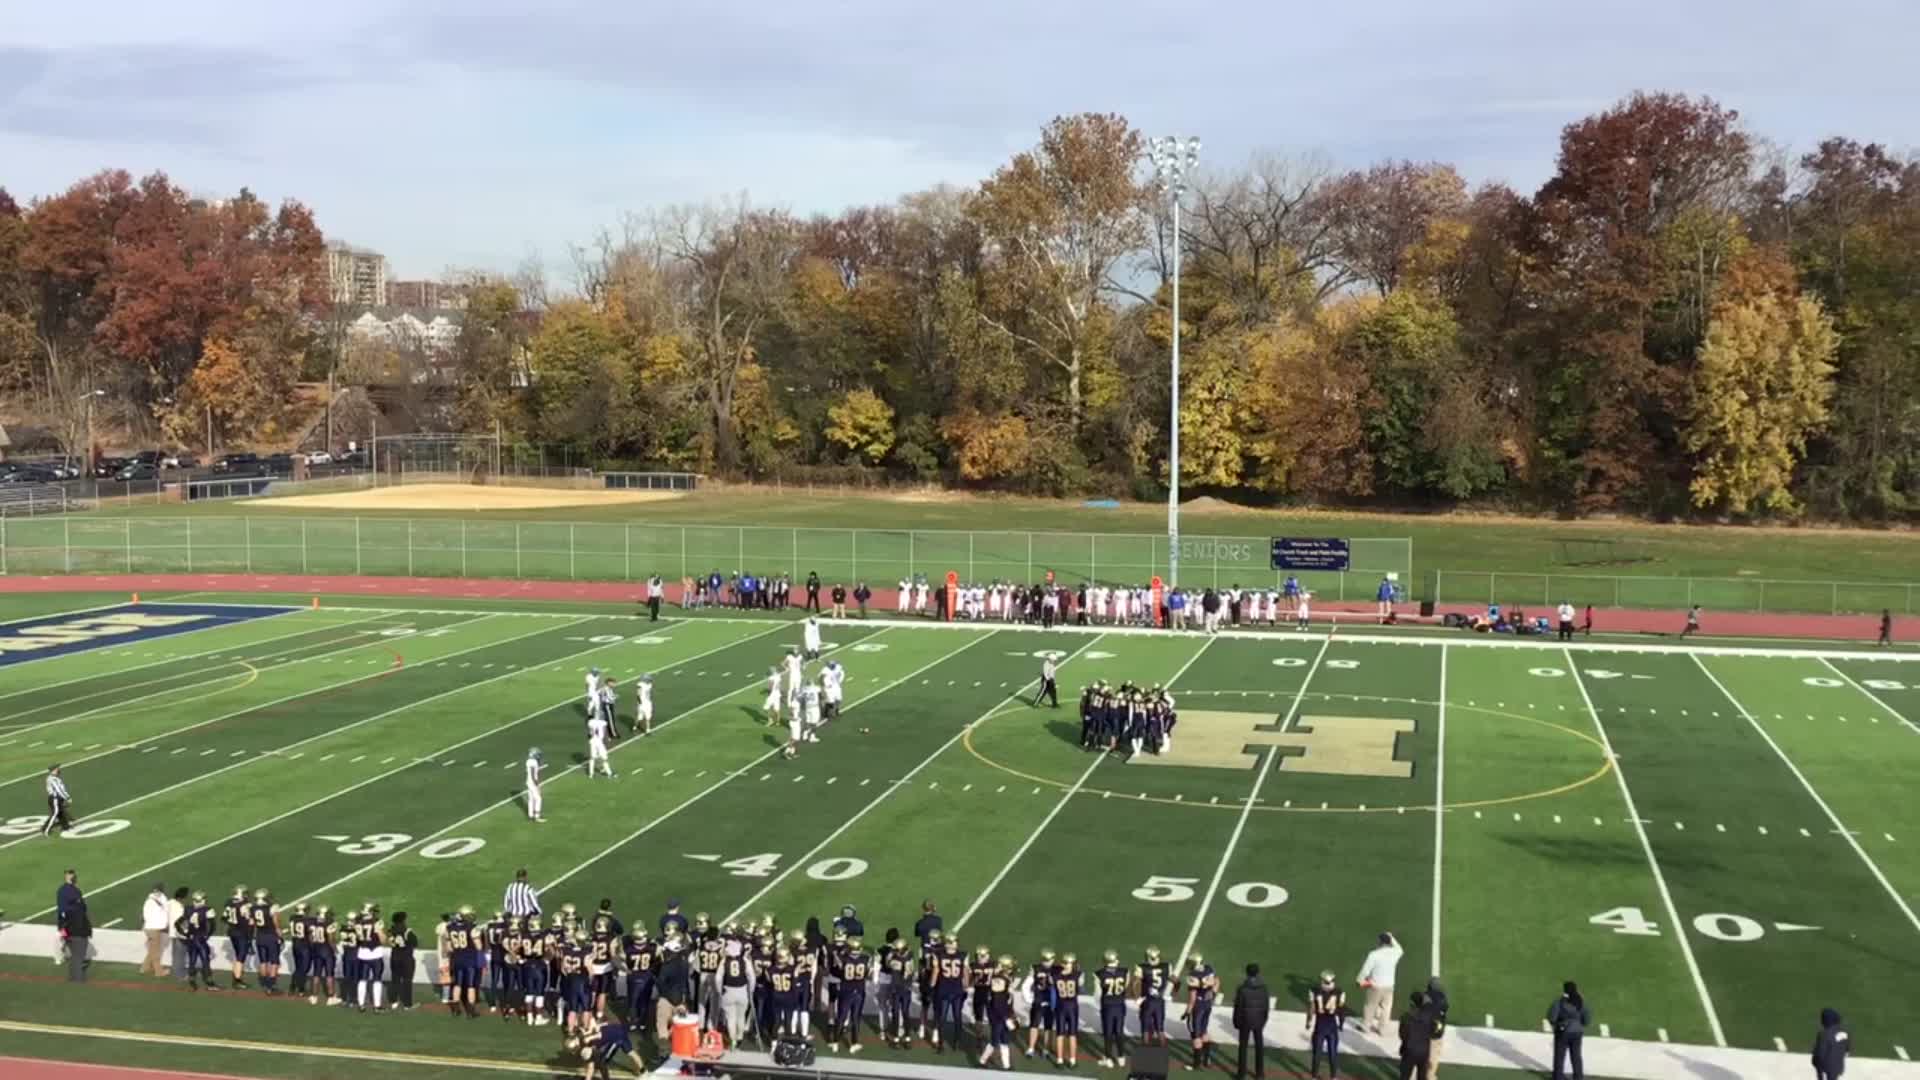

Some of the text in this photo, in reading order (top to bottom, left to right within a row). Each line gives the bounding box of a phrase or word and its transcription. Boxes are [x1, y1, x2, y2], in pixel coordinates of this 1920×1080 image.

[254, 909, 265, 927] 9
[631, 953, 651, 971] 78
[700, 951, 718, 970] 38
[941, 959, 961, 978] 56
[1105, 977, 1125, 996] 76
[1151, 968, 1163, 988] 5
[1316, 995, 1337, 1014] 14
